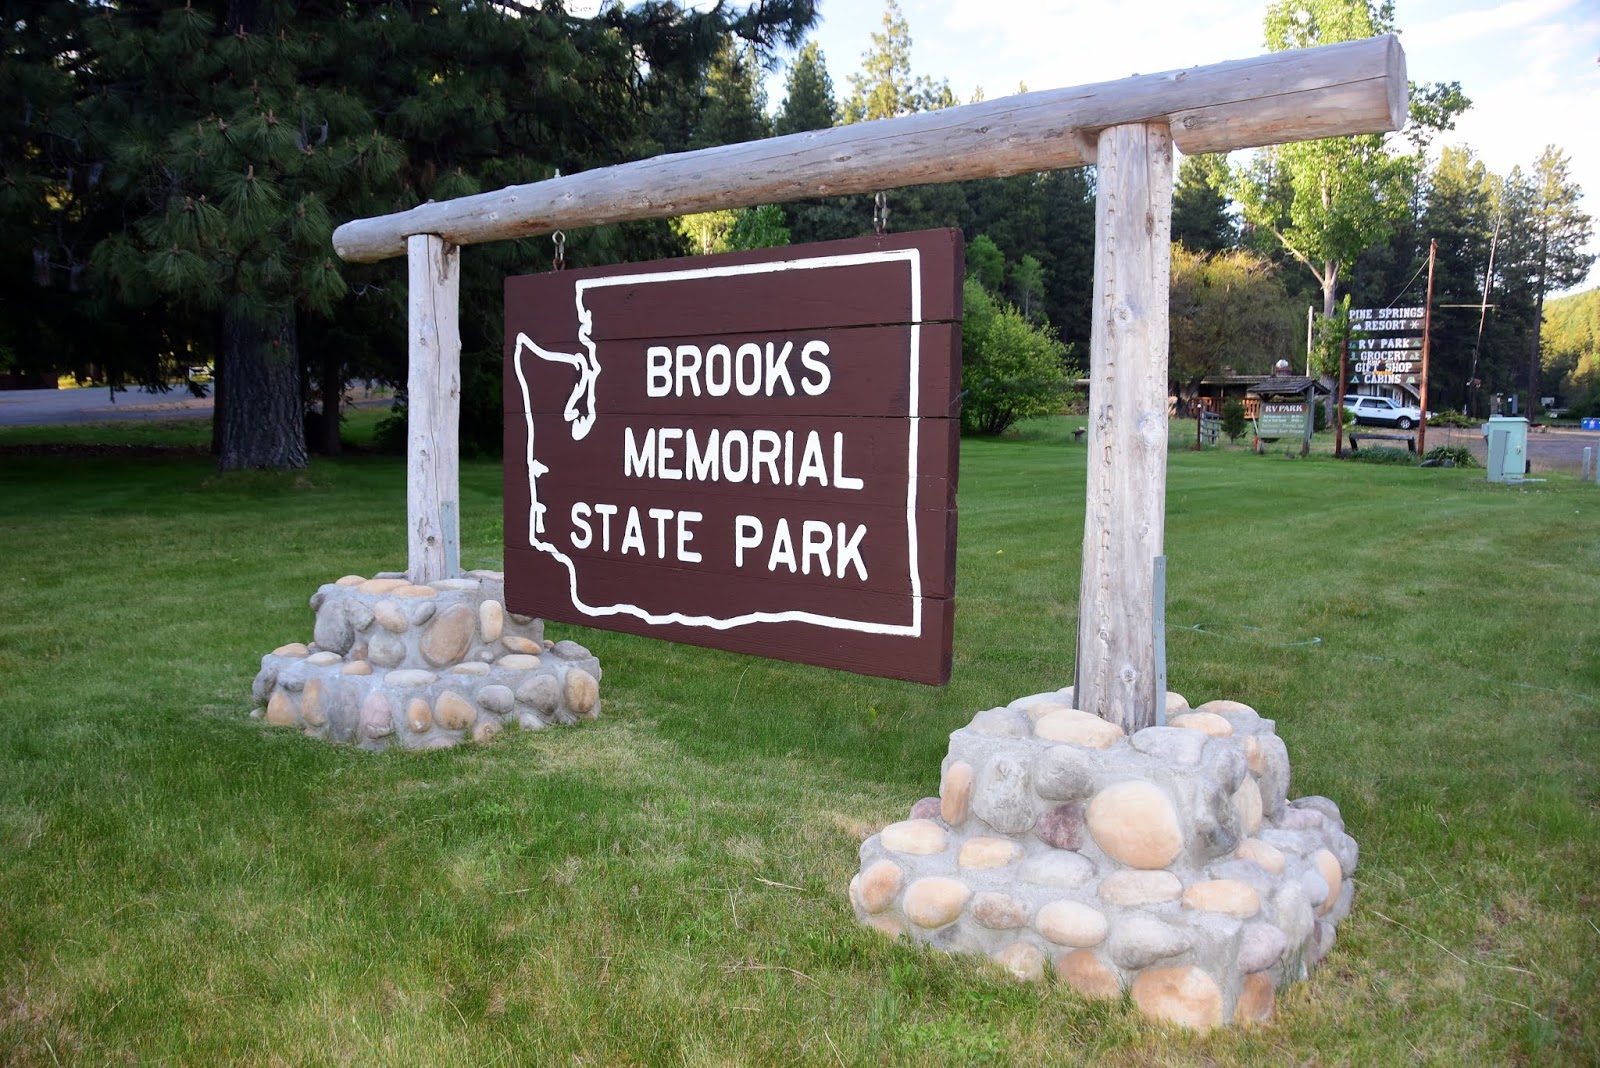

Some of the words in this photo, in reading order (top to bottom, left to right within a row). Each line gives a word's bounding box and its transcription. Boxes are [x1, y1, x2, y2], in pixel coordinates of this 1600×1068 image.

[1349, 309, 1373, 319] PINE
[1379, 307, 1424, 319] SPRINGS
[1365, 320, 1406, 331] RESORT
[1358, 339, 1375, 350] RV
[1380, 338, 1410, 349] PARK
[1360, 350, 1408, 361] GROCERY
[646, 340, 831, 398] BROOKS
[1355, 362, 1379, 373] GIFT
[1385, 362, 1413, 373] SHOP
[1364, 374, 1402, 384] CABINS
[624, 426, 864, 490] MEMORIAL
[570, 501, 703, 563] STATE
[735, 515, 869, 582] PARK
